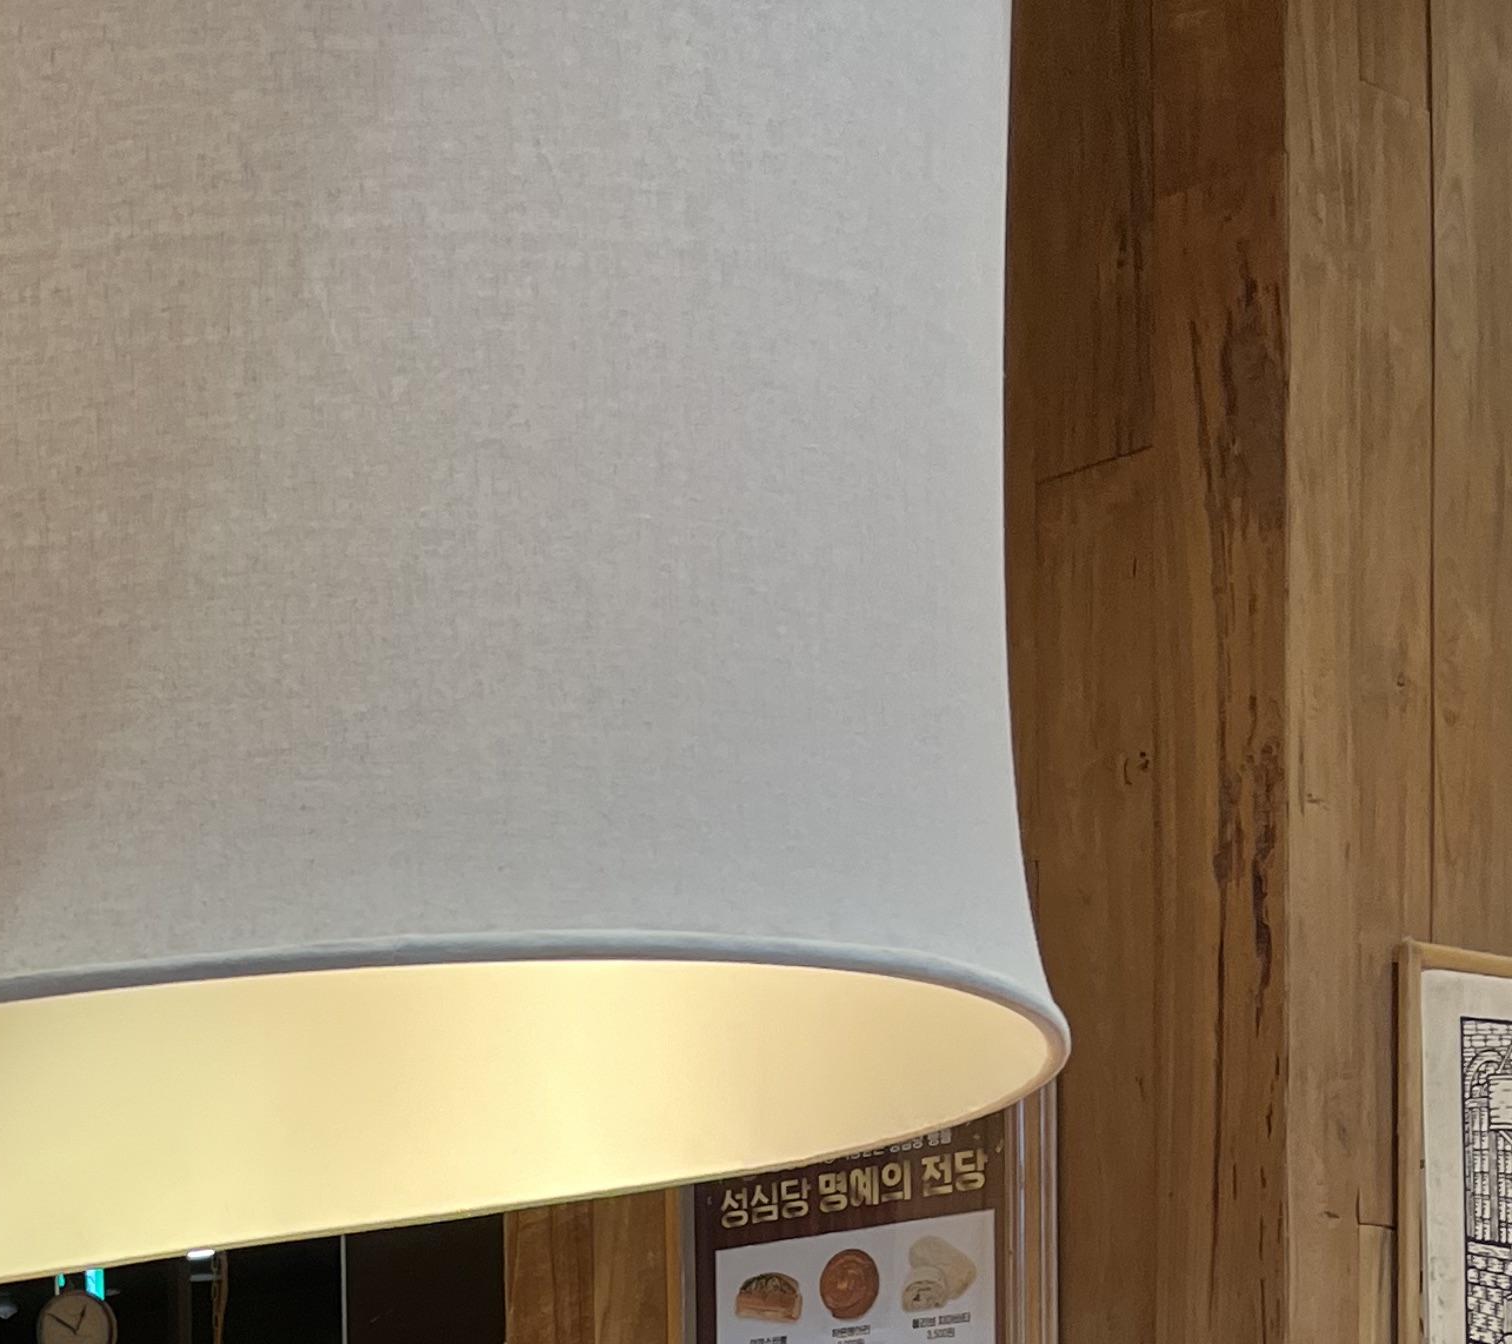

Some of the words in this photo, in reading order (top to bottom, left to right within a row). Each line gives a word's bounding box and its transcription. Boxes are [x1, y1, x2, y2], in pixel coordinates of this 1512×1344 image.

[720, 1178, 812, 1229] 성심당
[818, 1159, 912, 1213] 명예의
[921, 1148, 989, 1198] 전당
